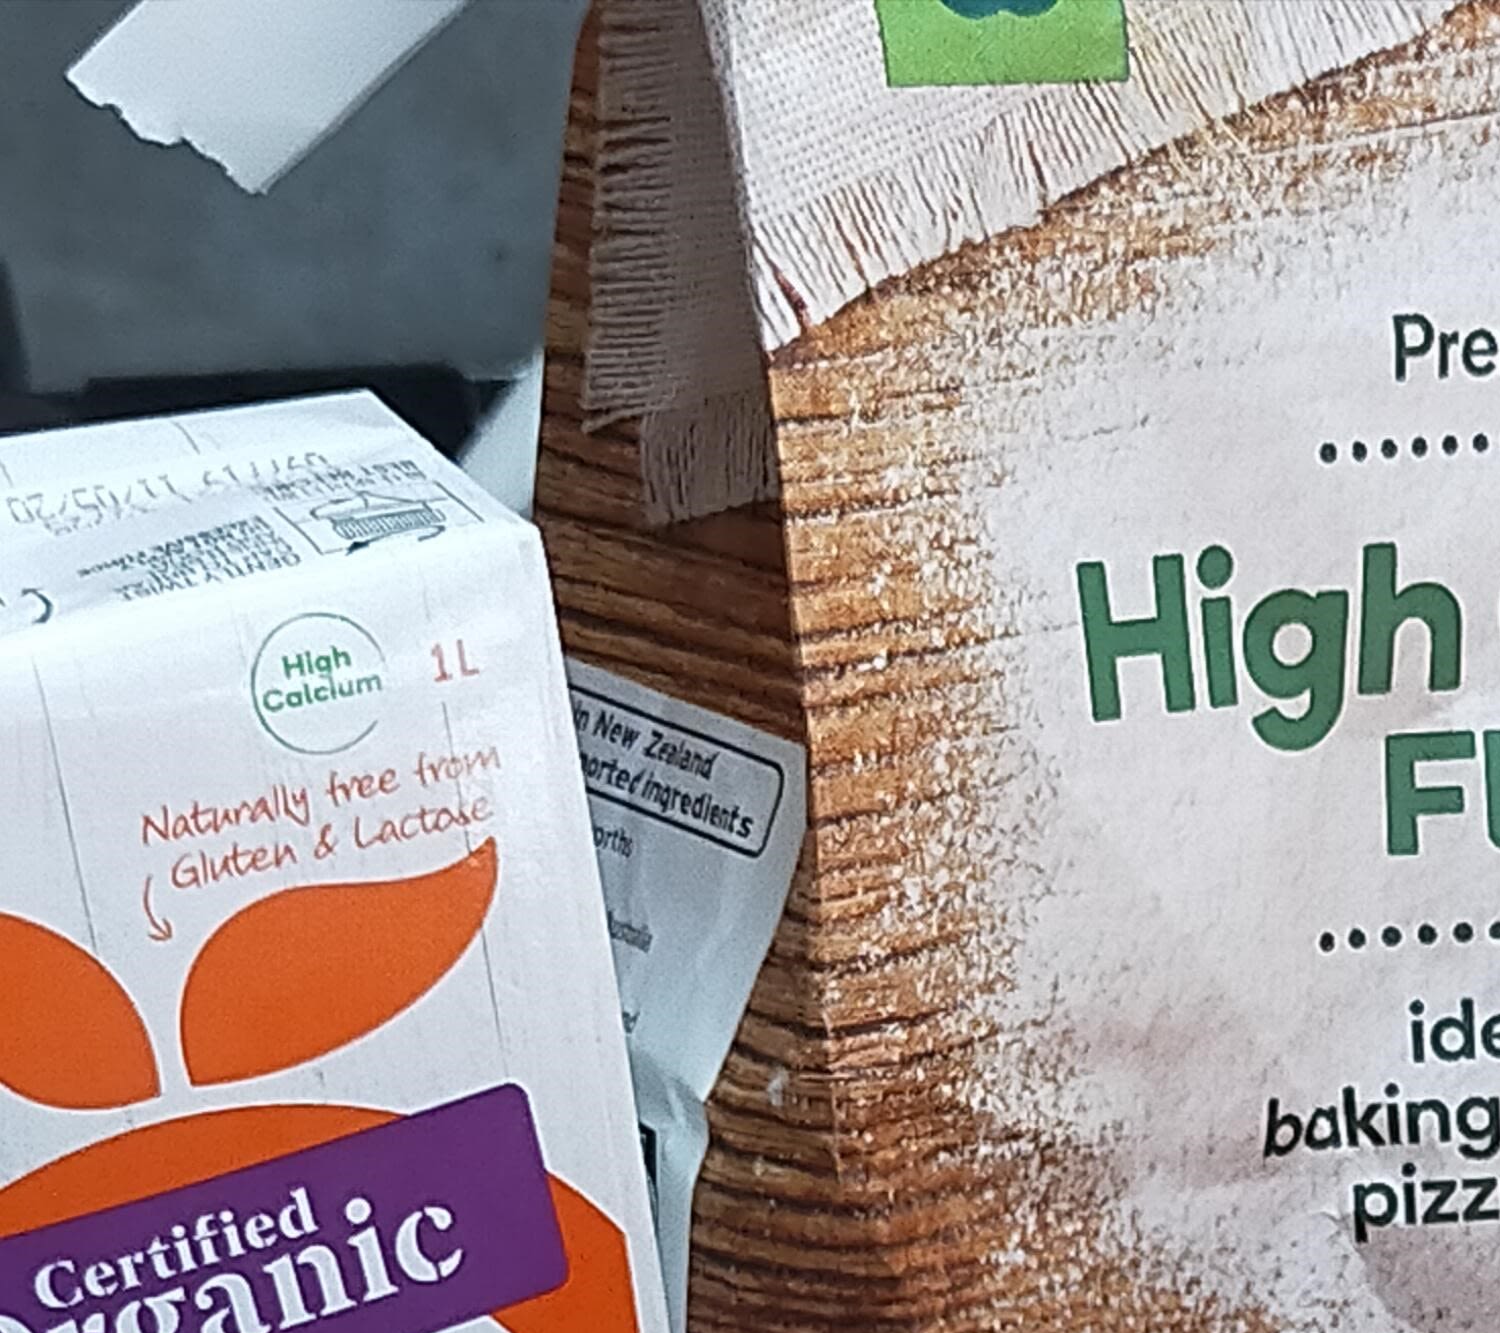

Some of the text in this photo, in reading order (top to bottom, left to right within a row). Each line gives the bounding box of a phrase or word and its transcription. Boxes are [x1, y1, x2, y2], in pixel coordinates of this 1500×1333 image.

[261, 672, 383, 713] Calcium
[282, 645, 352, 682] High
[1076, 543, 1464, 751] High
[592, 708, 641, 751] New
[642, 729, 721, 781] Zealand
[140, 746, 502, 846] Naturally free from
[580, 751, 755, 840] ported ingredients
[170, 795, 495, 889] Gluten & Lactose
[33, 1186, 319, 1310] Certified
